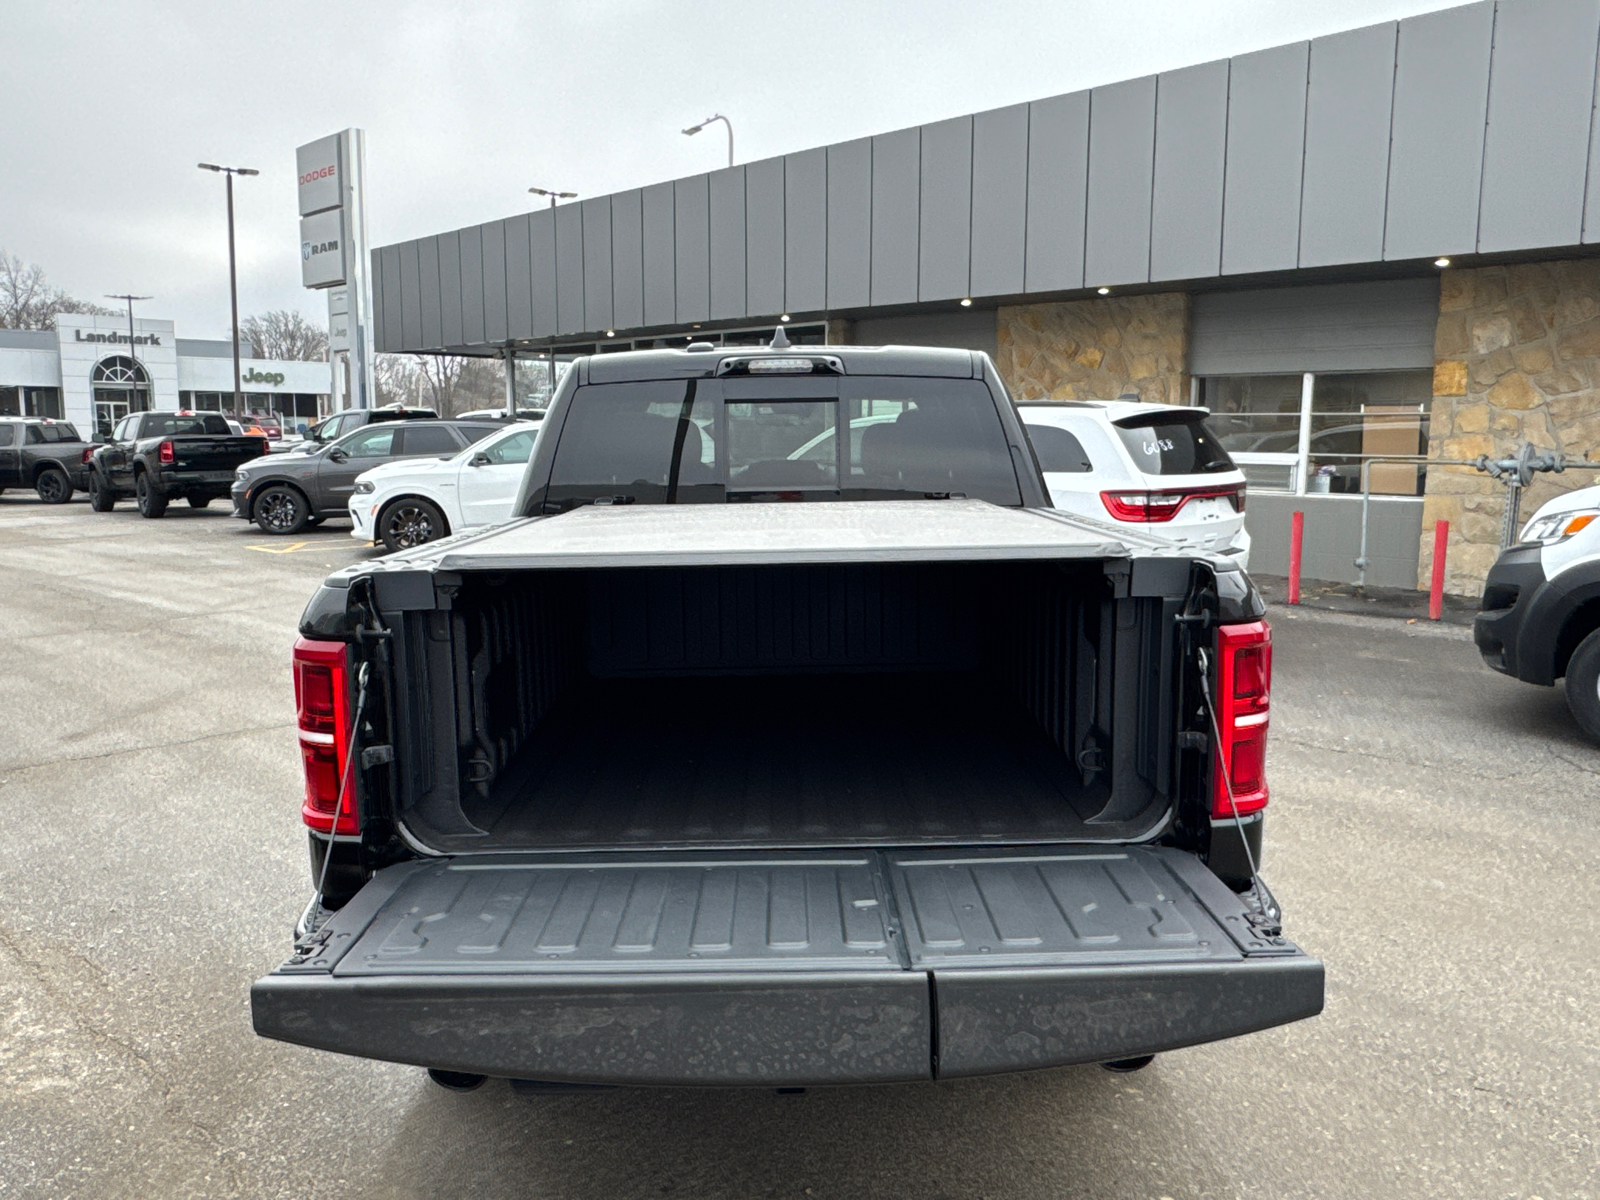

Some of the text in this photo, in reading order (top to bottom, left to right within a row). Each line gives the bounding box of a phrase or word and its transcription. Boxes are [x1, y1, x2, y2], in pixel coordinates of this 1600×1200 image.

[299, 165, 335, 186] DODGE
[311, 240, 338, 255] RAM
[75, 329, 161, 346] Landmark
[242, 367, 285, 387] Jeep
